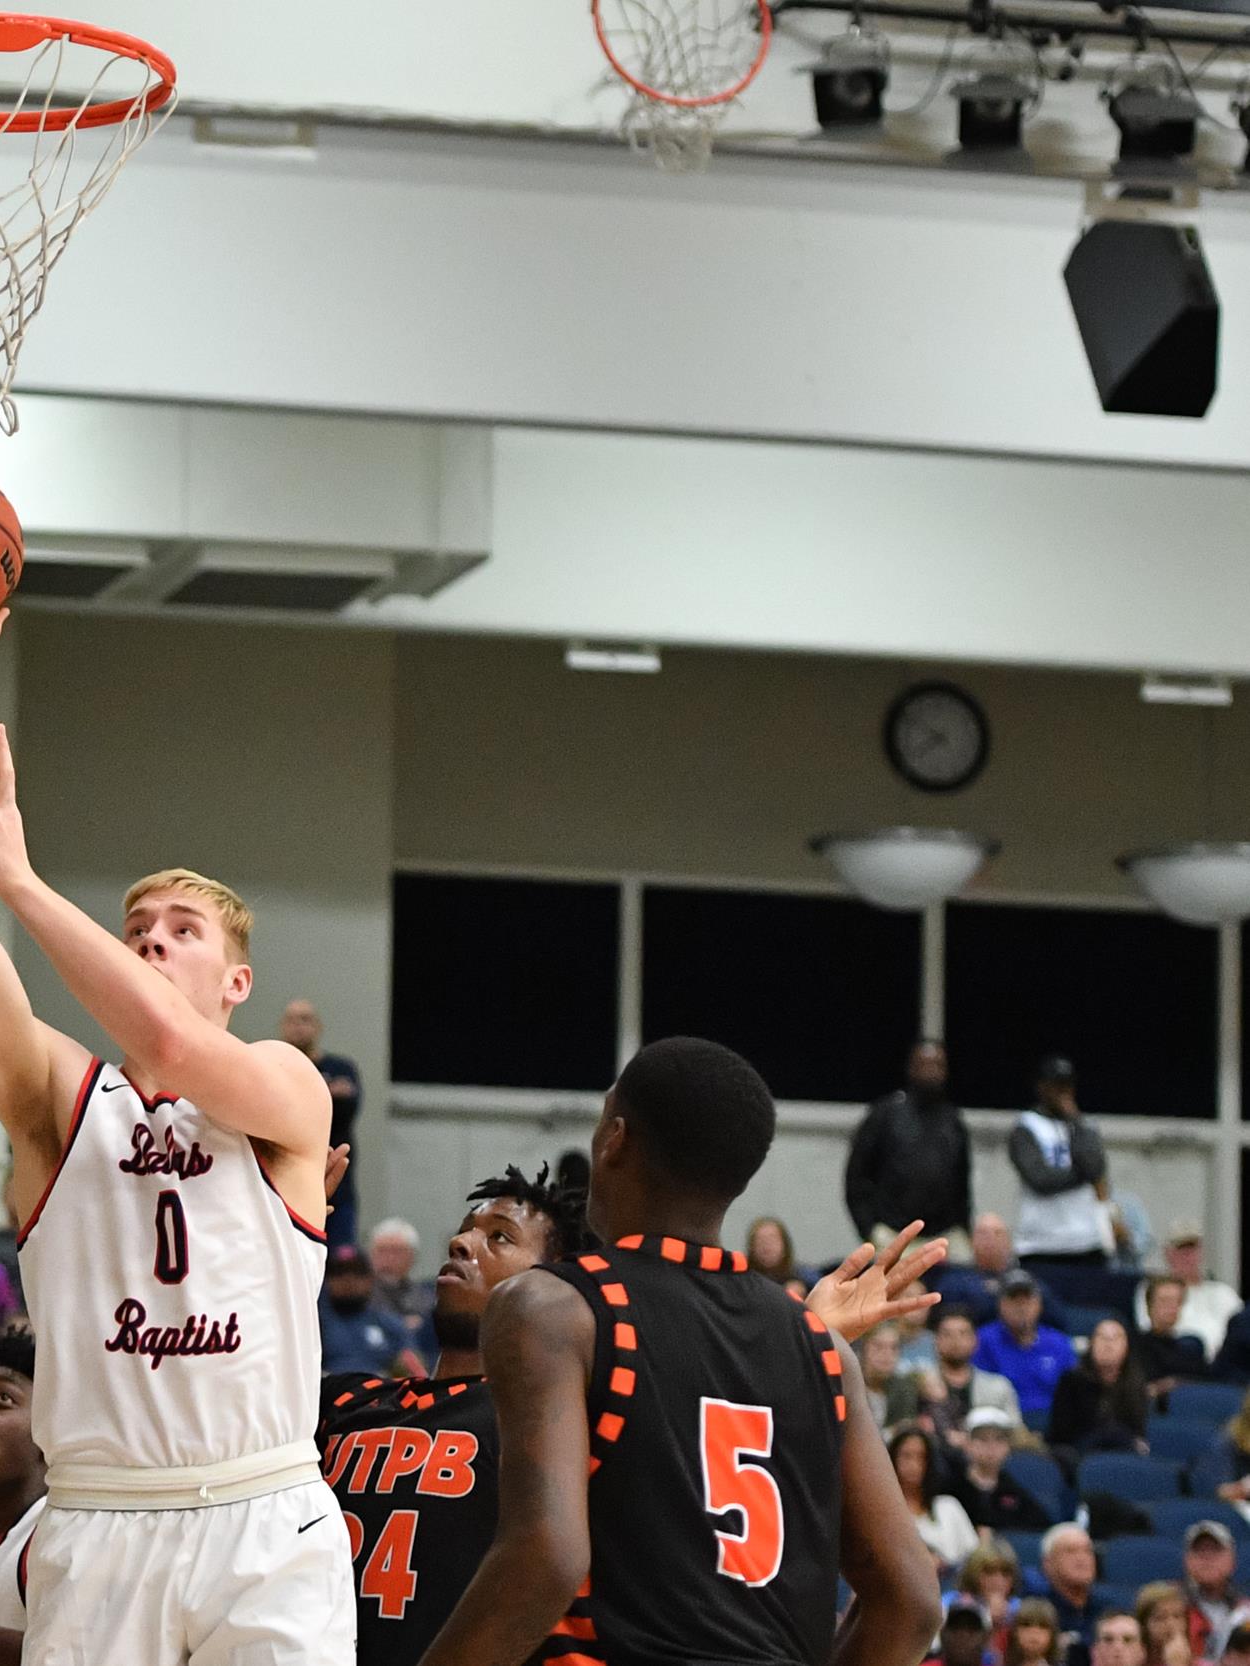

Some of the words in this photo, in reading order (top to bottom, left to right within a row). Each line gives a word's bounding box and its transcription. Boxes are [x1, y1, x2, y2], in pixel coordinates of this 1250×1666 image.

[153, 1189, 189, 1285] 0
[104, 1297, 241, 1371] Baptist
[323, 1426, 479, 1498] UTPB
[699, 1396, 784, 1588] 5
